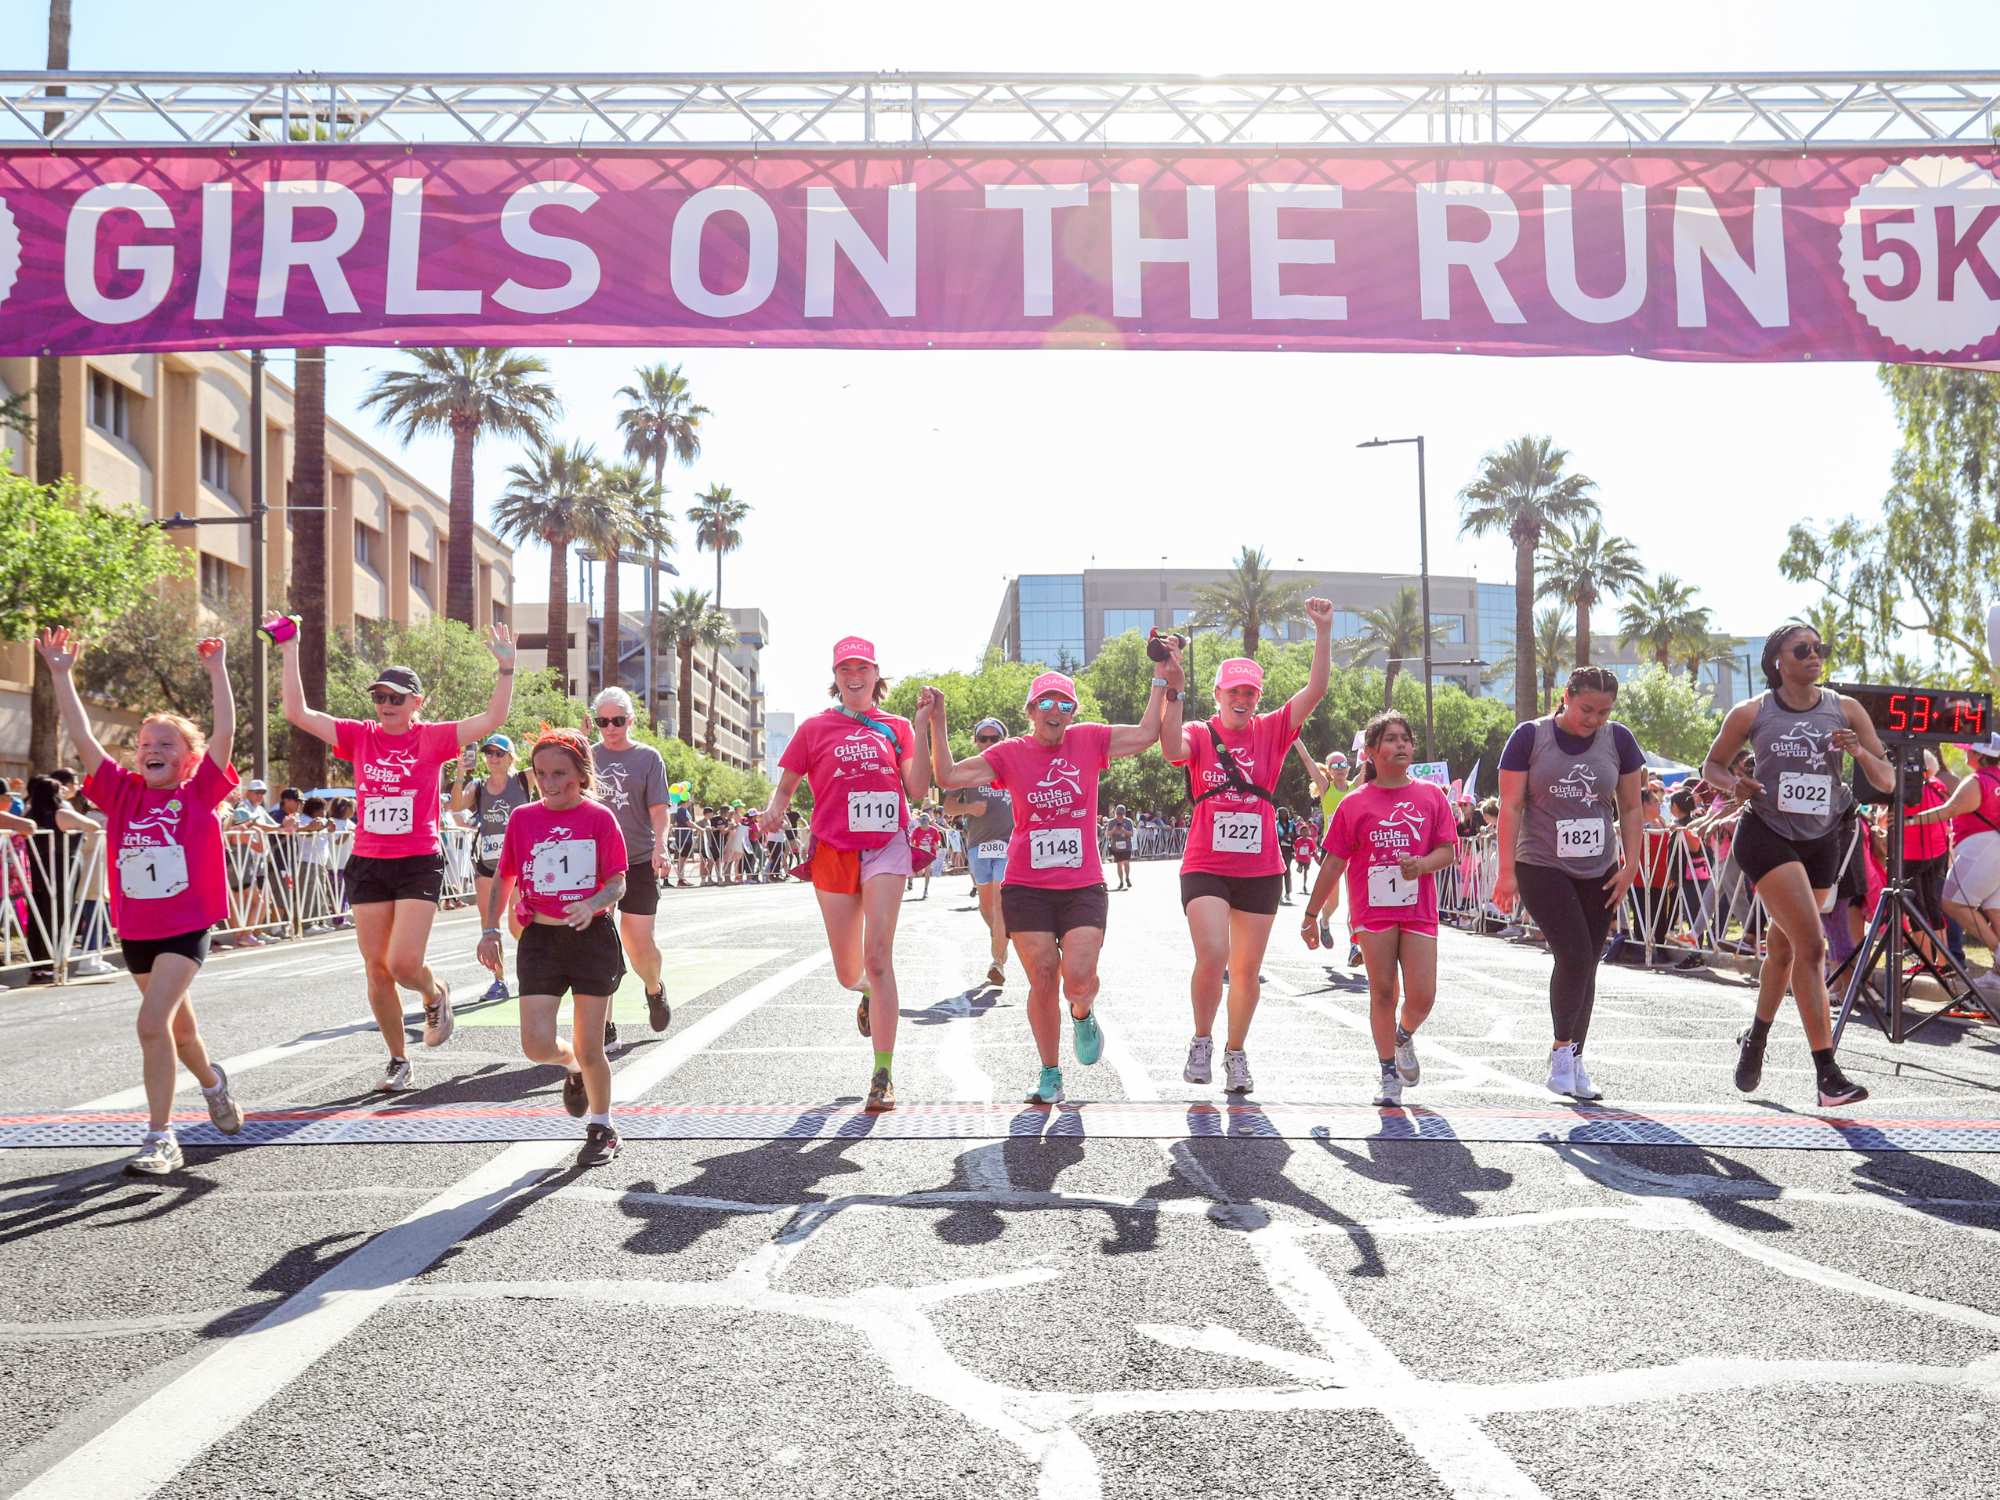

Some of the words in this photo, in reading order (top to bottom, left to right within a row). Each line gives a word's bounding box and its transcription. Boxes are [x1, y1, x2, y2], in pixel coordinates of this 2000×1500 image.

[64, 177, 600, 325] GIRLS
[670, 181, 917, 318] ON
[985, 182, 1347, 320] THE
[1416, 181, 1790, 327] RUN
[1860, 205, 2000, 302] 5K
[838, 643, 870, 655] COACH
[1229, 667, 1260, 680] COACH
[1039, 679, 1072, 688] COACH
[834, 742, 868, 757] Girls
[1770, 741, 1801, 752] Girls
[853, 750, 878, 761] run
[363, 763, 393, 778] Girls
[1027, 789, 1063, 804] Girls
[1549, 785, 1577, 794] Girls
[1783, 785, 1826, 802] 3022
[1047, 796, 1073, 809] run
[369, 807, 409, 823] 1173
[853, 803, 895, 819] 1110
[1219, 823, 1258, 840] 1227
[1369, 829, 1401, 842] Girls
[1562, 829, 1600, 845] 1821
[981, 843, 1004, 852] 2080
[1036, 840, 1079, 856] 1148
[1384, 838, 1410, 848] run
[559, 855, 569, 874] 1
[145, 863, 156, 882] 1
[1388, 877, 1397, 893] 1
